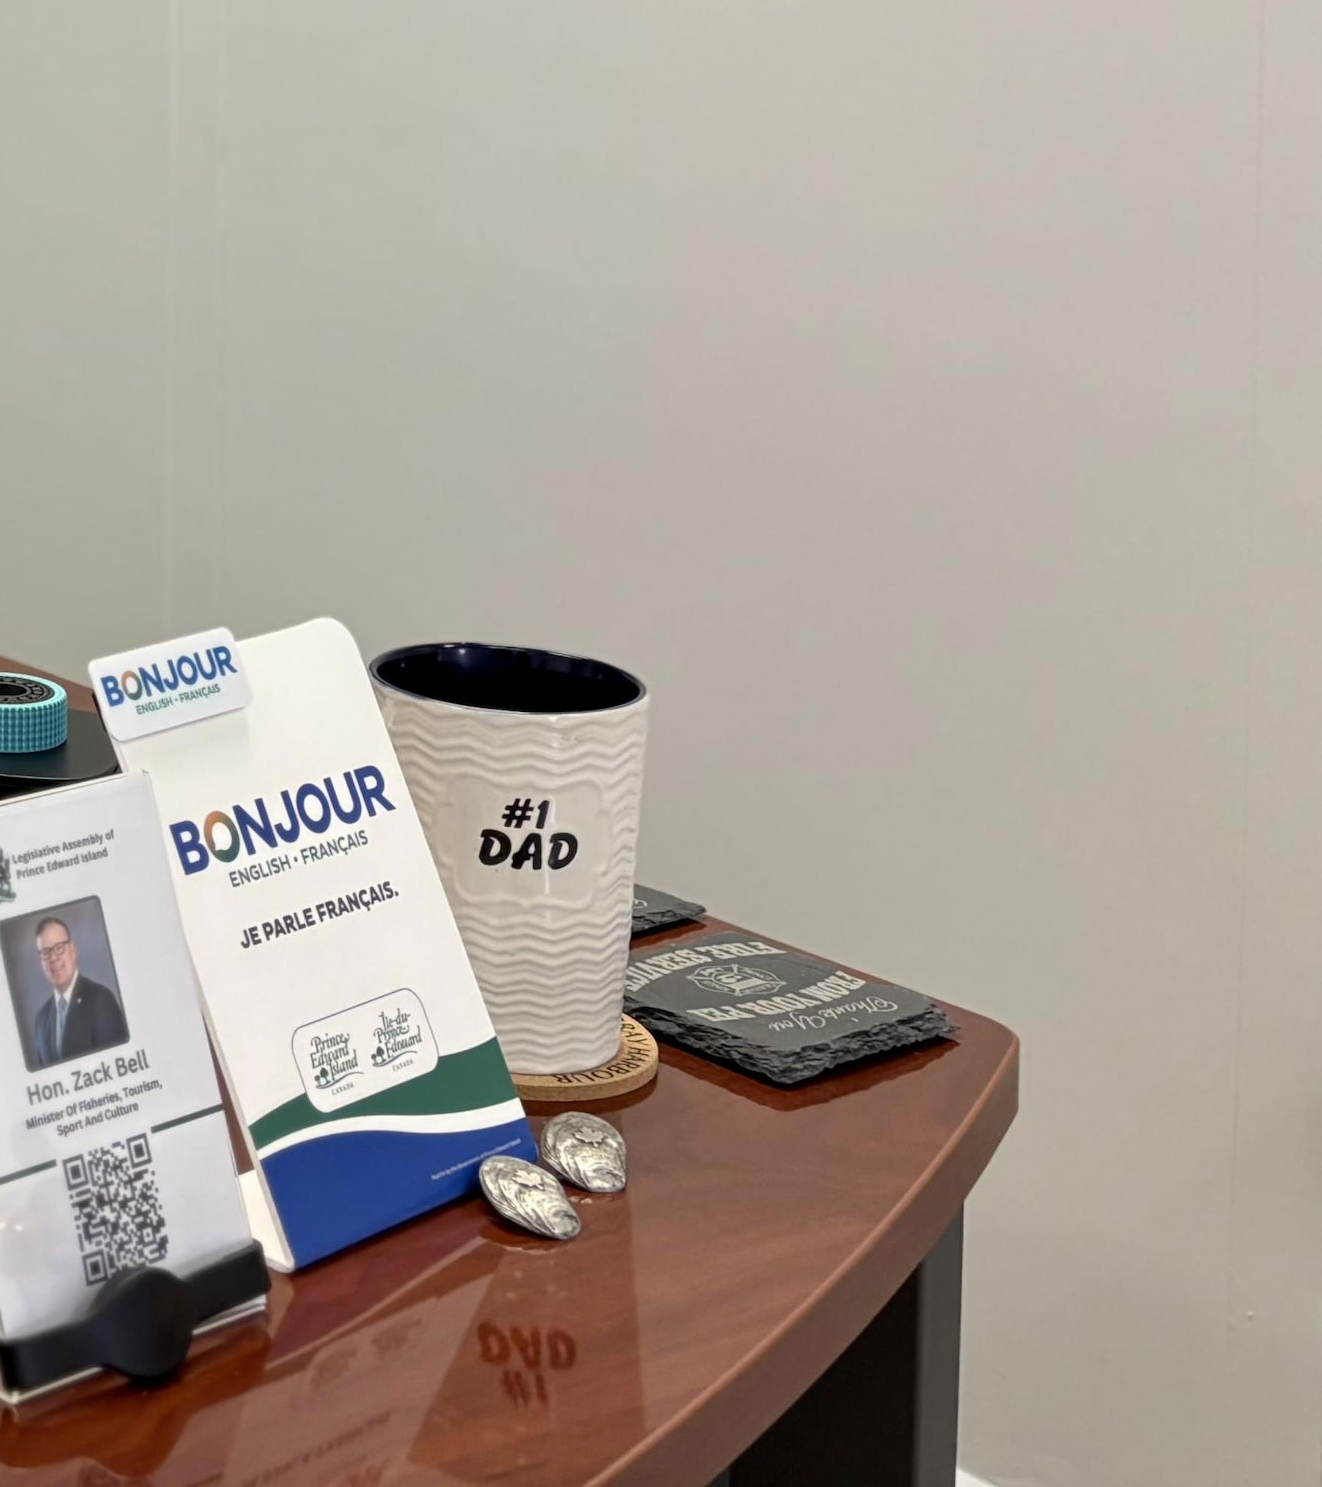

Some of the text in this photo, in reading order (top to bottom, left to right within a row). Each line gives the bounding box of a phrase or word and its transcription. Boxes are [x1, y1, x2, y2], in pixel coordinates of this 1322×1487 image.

[100, 645, 238, 707] BONJOUR
[135, 683, 221, 715] ENGLISH FRANÇAIS
[169, 765, 397, 876] BONJOUR
[501, 798, 550, 829] #1
[12, 829, 115, 864] Legislative Assembly of
[16, 847, 108, 879] Prince Edward Island
[229, 830, 370, 888] ENGLISH FRANÇAIS
[478, 829, 579, 871] DAD
[240, 881, 399, 949] JE PARLE FRANÇAIS.
[694, 941, 788, 960] FIRE
[798, 970, 867, 1002] FROM
[685, 1006, 756, 1021] PEI
[735, 993, 823, 1015] YOUR
[769, 996, 898, 1031] Thank You
[310, 1033, 351, 1053] Prince
[310, 1043, 350, 1070] Edward
[26, 1048, 150, 1106] Hon. Zack Bell
[329, 1049, 359, 1081] Island
[551, 1046, 650, 1084] HARBOUR
[25, 1079, 163, 1130] Minister Of Fisheries, Tourism,
[57, 1101, 139, 1137] Sport And Culture
